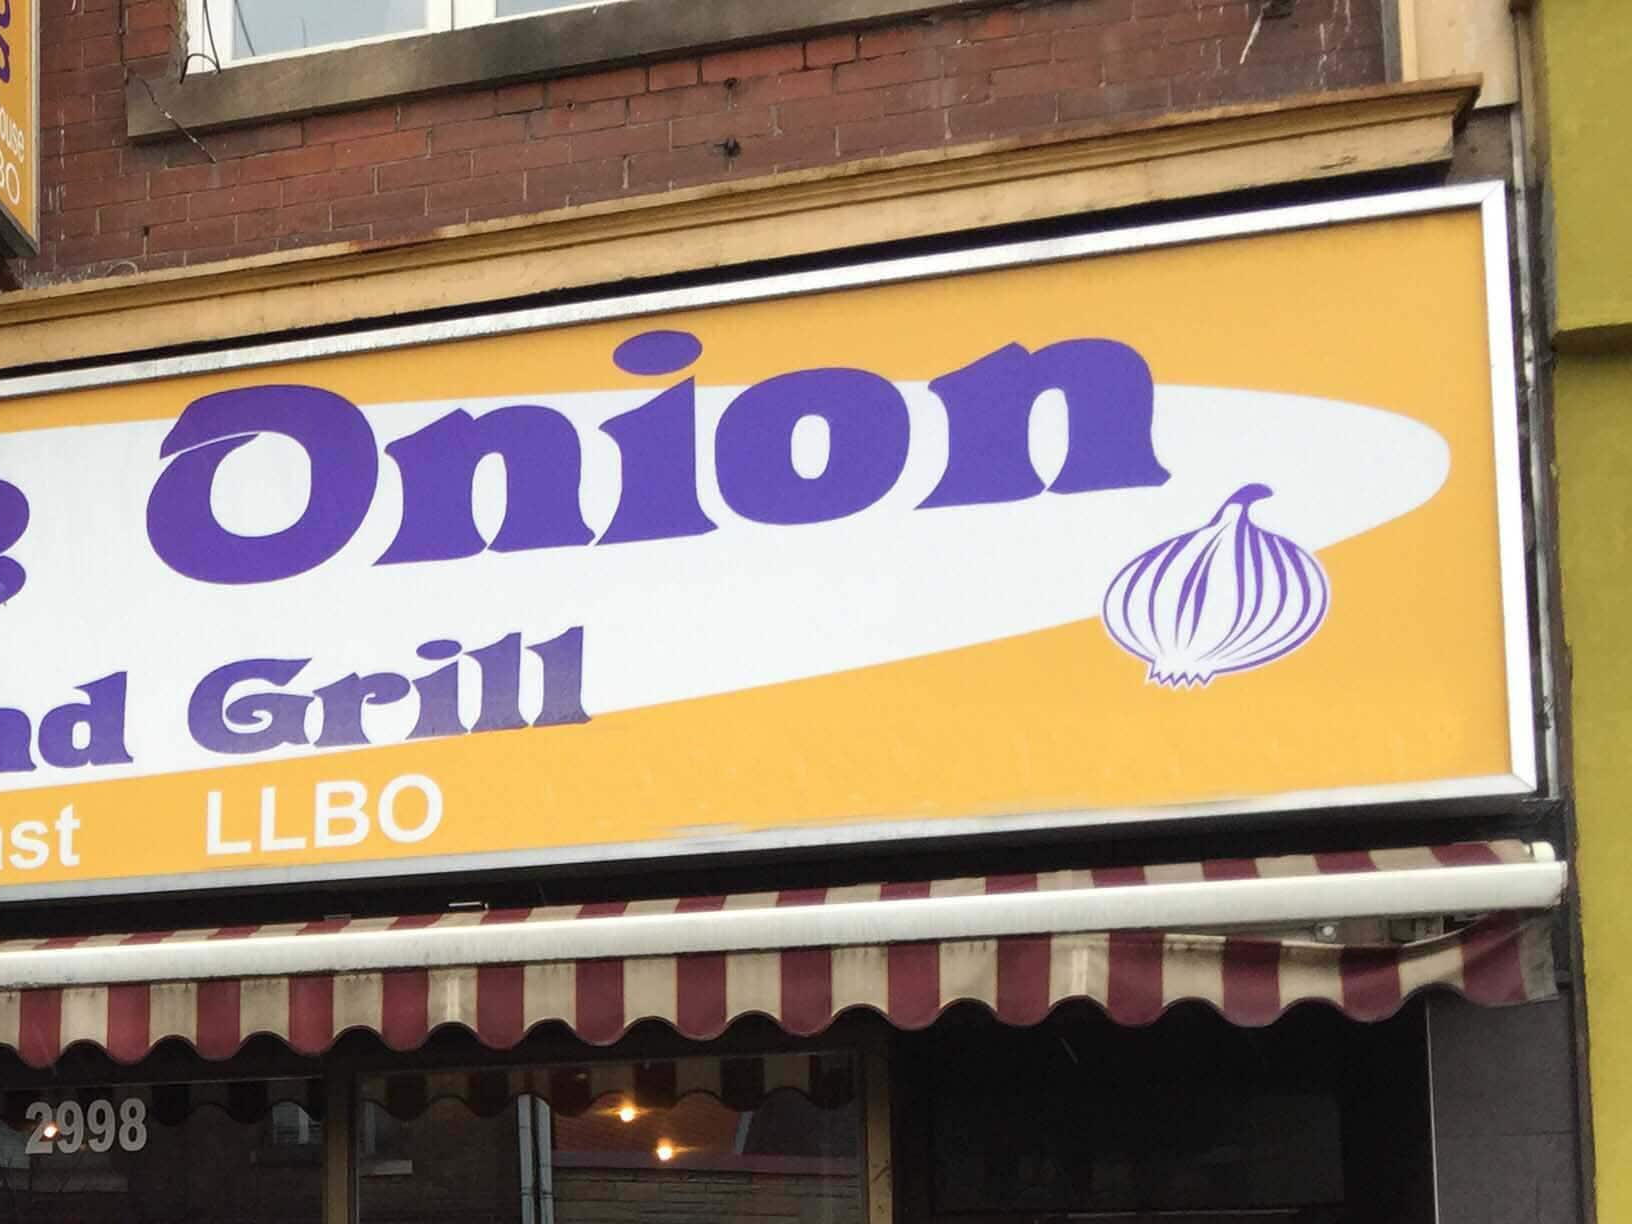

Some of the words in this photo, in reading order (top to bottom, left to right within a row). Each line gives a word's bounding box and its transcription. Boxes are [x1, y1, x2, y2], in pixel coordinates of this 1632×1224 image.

[146, 331, 1169, 585] Onion
[189, 626, 585, 748] Grill
[206, 773, 443, 855] LLBO
[25, 1097, 148, 1155] 2998
